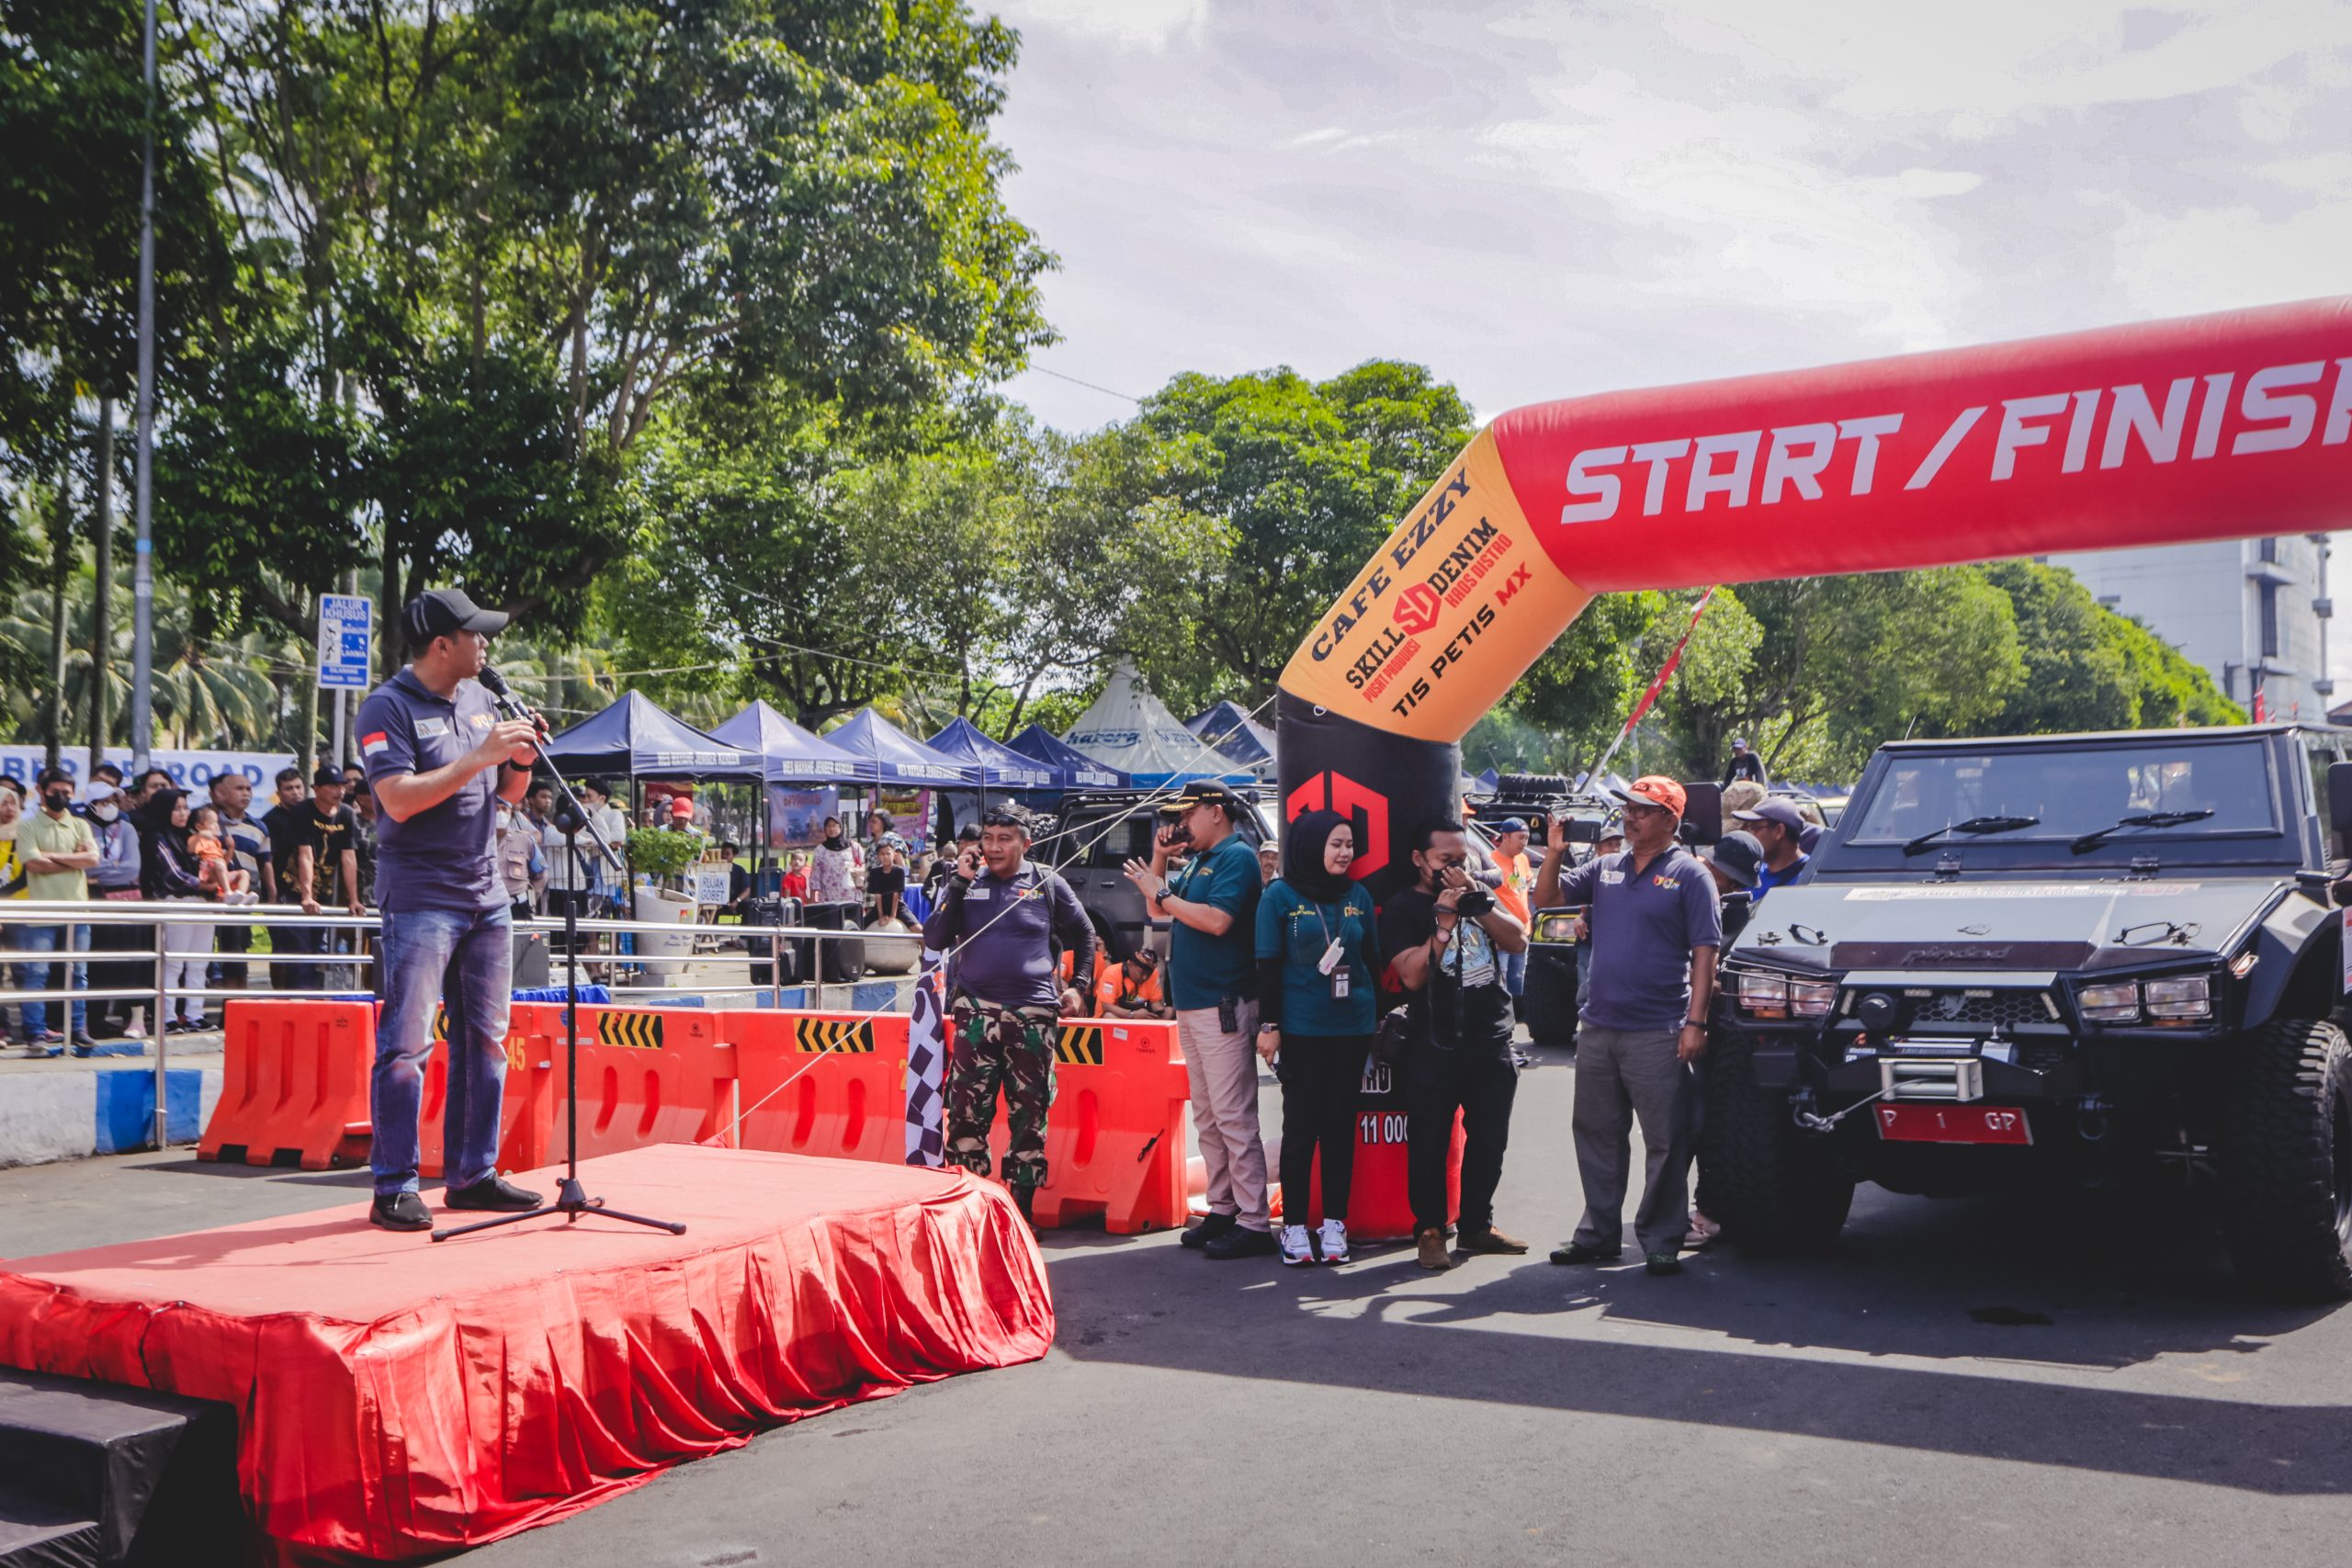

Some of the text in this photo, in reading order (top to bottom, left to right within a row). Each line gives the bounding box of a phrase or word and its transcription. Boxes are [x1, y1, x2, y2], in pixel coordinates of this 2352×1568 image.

[1561, 413, 1904, 524] START
[1312, 467, 1470, 661] CAFE EZZY
[1474, 533, 1513, 581] DISTRO
[325, 608, 368, 621] KHUSUS
[1346, 627, 1405, 689] SKILL
[1427, 516, 1498, 595] DENIM
[1392, 561, 1533, 717] TIS PETIS MX
[1362, 638, 1421, 704] PUSAT PRODUKSI
[701, 889, 725, 902] GOBET
[703, 876, 725, 890] RUJAK
[1361, 1114, 1378, 1144] 11
[1882, 1109, 2017, 1131] P 1 GP
